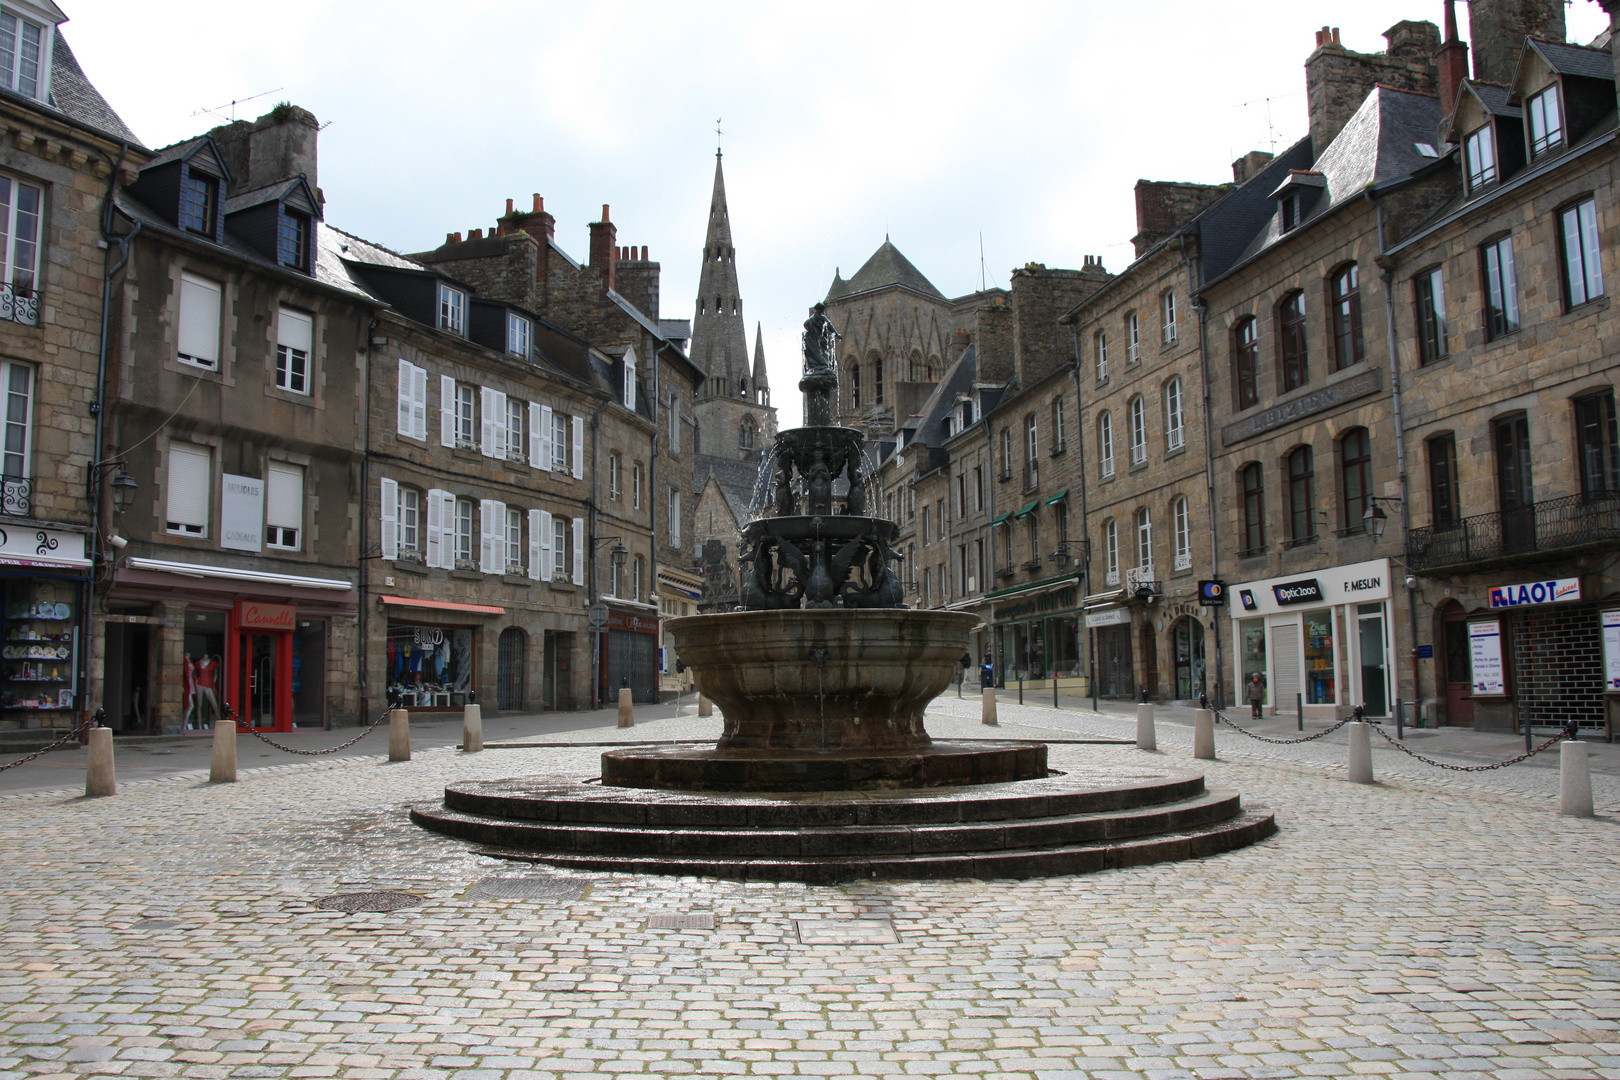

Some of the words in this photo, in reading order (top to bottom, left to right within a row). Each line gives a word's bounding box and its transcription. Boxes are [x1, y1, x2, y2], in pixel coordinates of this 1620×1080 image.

[1351, 577, 1380, 591] MESLIN
[1507, 581, 1557, 605] LAOT
[245, 606, 294, 626] Cannelle
